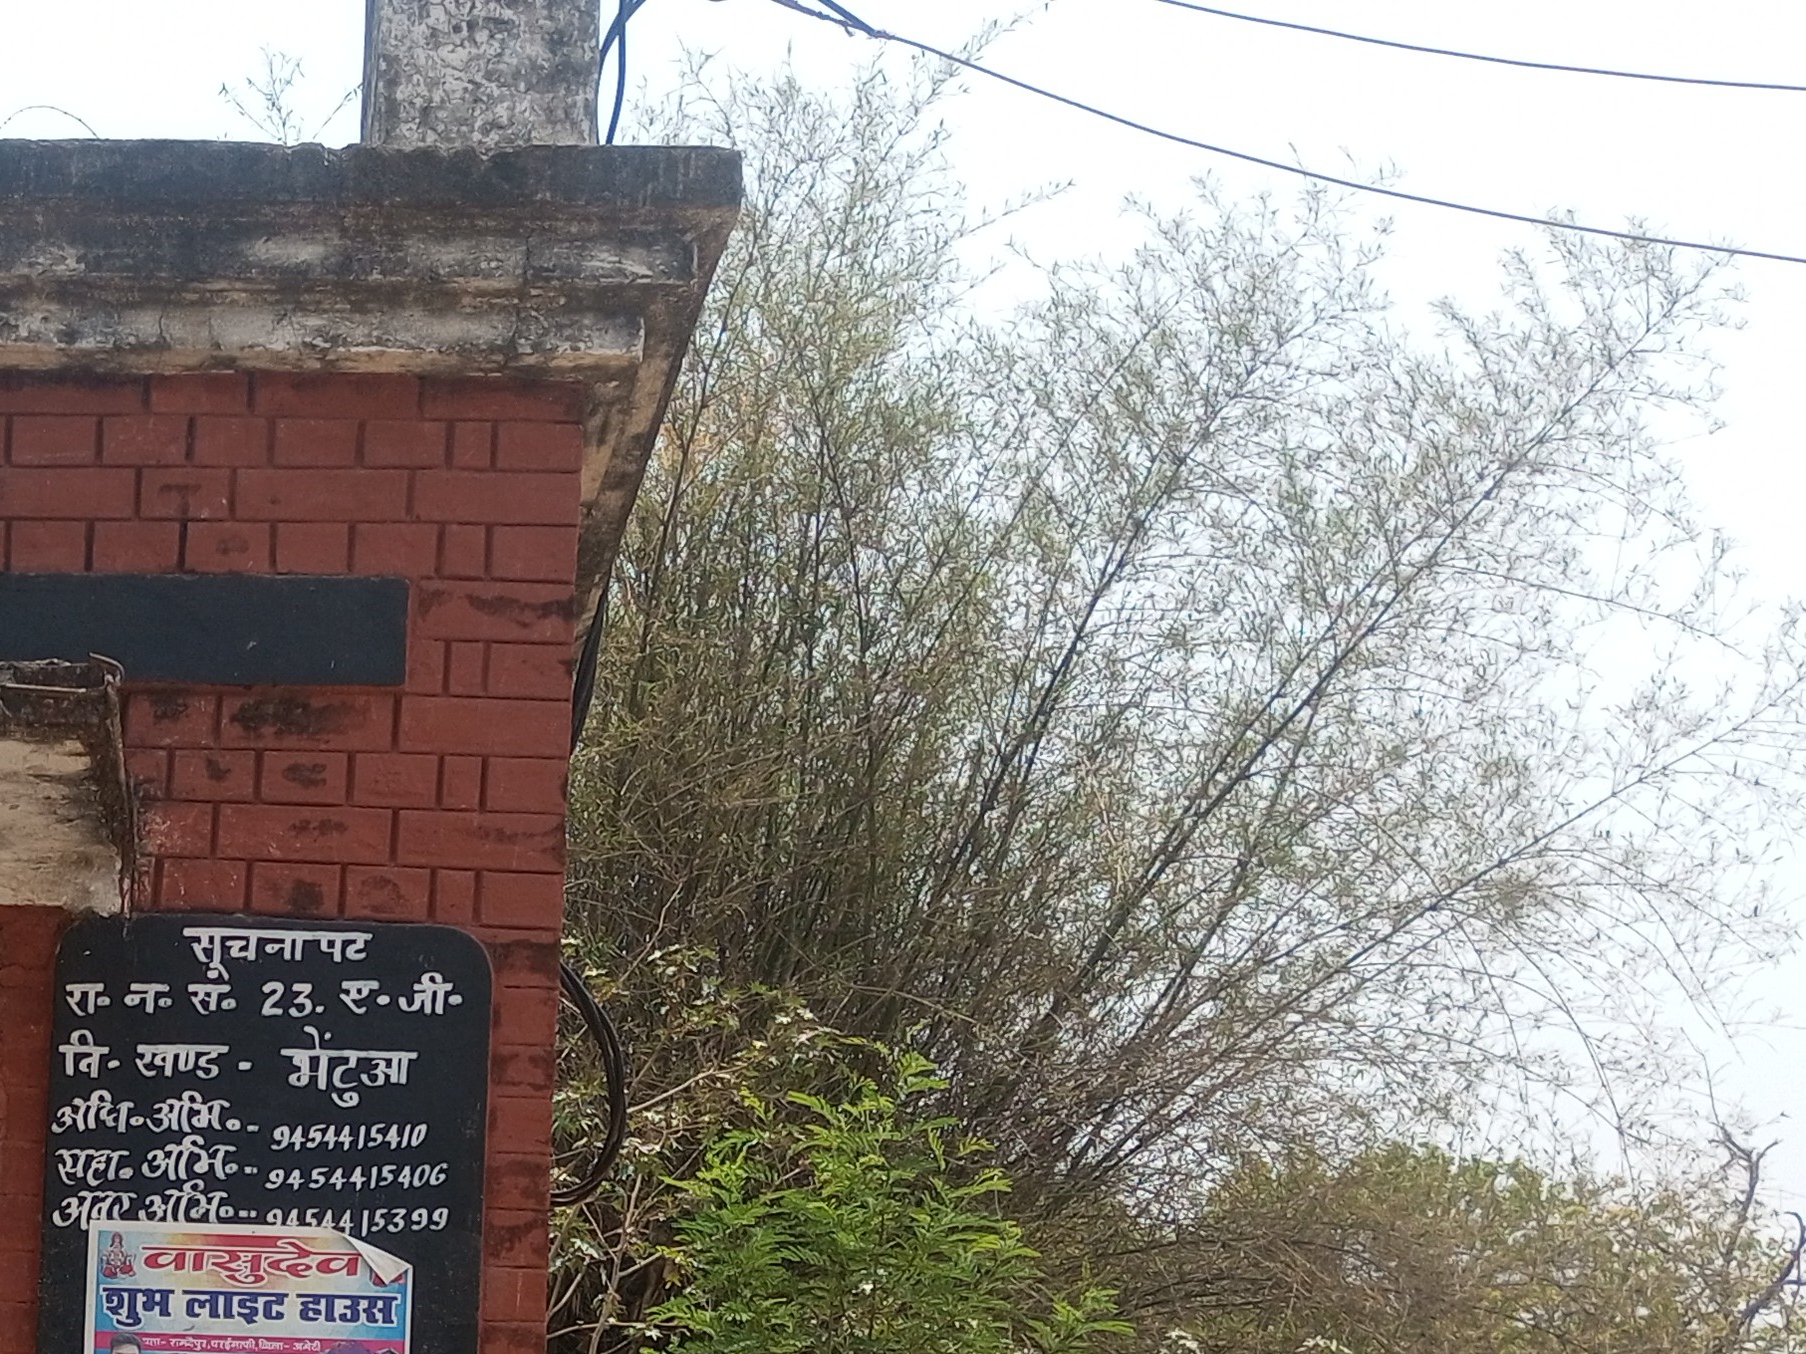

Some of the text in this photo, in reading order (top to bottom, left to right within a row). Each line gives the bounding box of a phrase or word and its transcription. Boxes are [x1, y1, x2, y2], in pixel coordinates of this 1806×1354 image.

[270, 1122, 429, 1152] 9454415410
[264, 1162, 450, 1192] 9454415406
[265, 1207, 450, 1238] 9454415399
[141, 1241, 363, 1285] वासुदेव
[102, 1287, 399, 1328] शुभ लाइट हाउस
[292, 1340, 321, 1352] अमेठी
